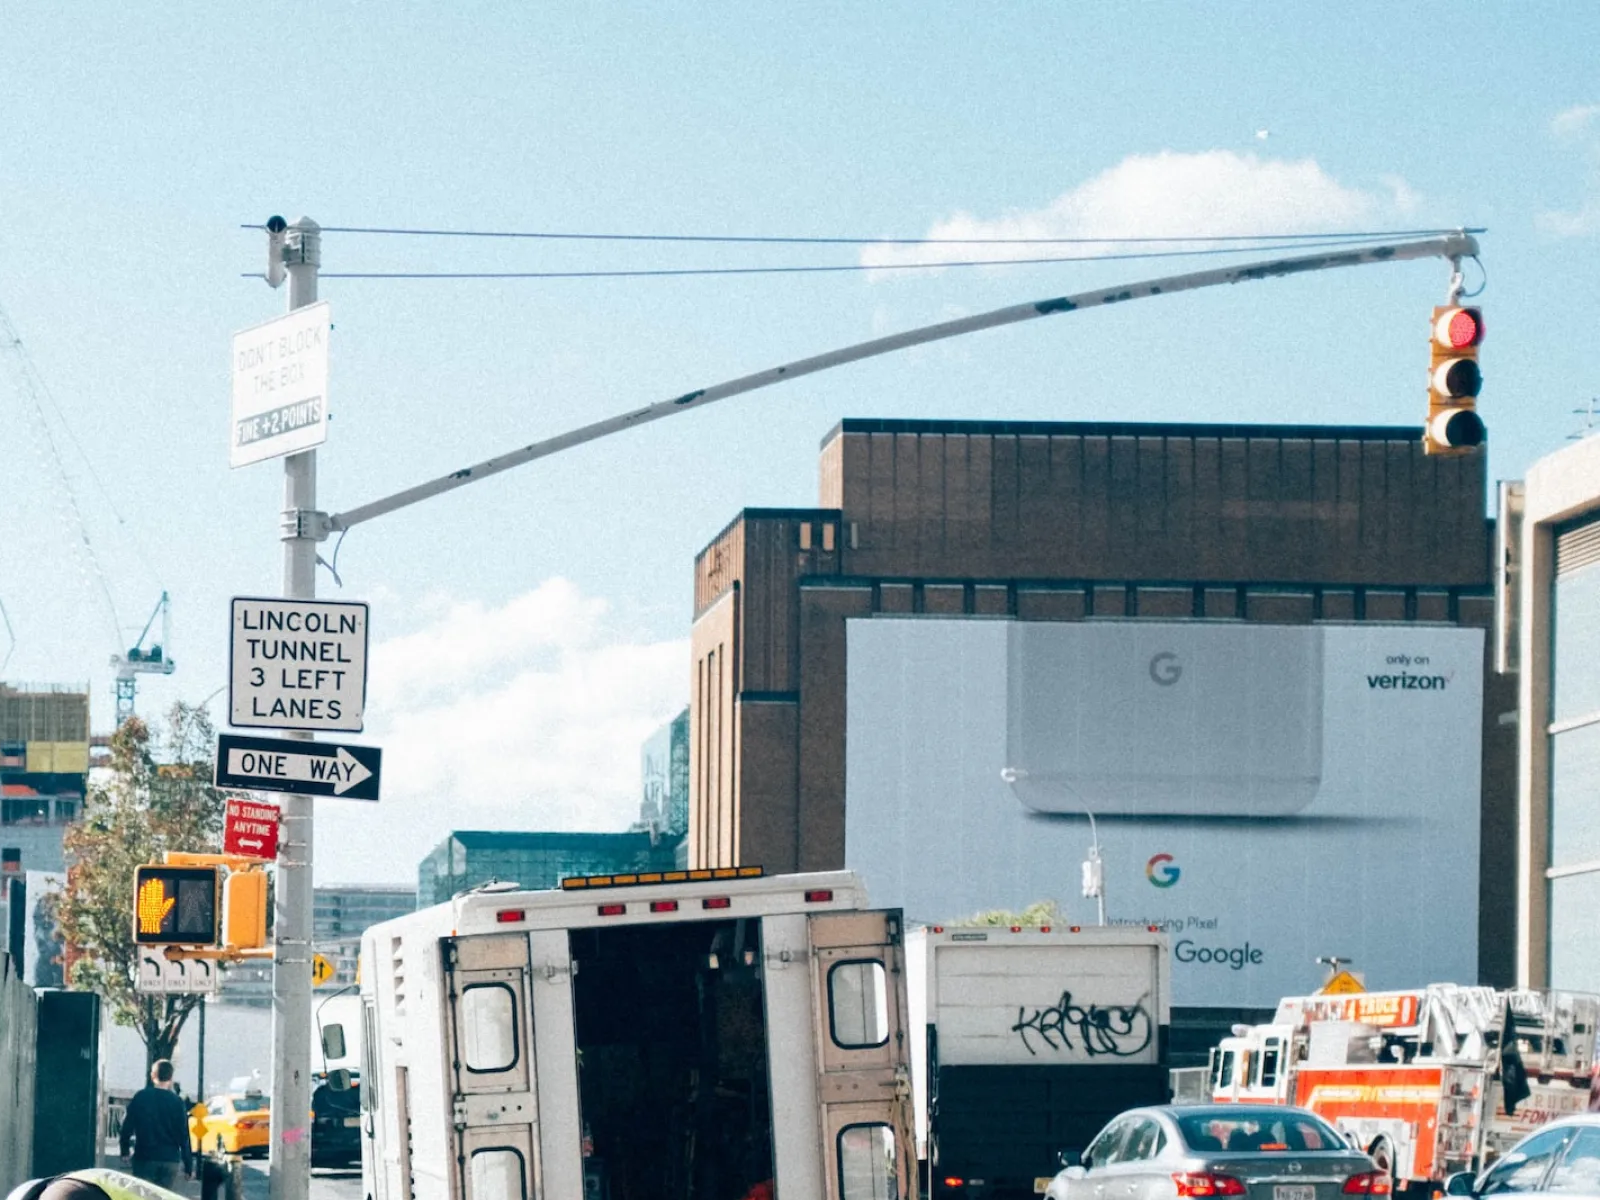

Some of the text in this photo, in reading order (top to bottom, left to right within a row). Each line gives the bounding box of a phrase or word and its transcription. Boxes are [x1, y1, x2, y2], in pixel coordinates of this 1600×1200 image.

[238, 326, 322, 372] DON'T BLOCK
[253, 370, 276, 394] THE
[280, 398, 321, 431] POINTS
[243, 609, 356, 634] LINCOLN
[246, 639, 351, 663] TUNNEL
[1386, 654, 1430, 666] only on
[250, 667, 346, 691] 3 LEFT
[1366, 671, 1446, 690] verizon
[253, 696, 342, 720] LANES
[241, 752, 356, 782] ONE WAY
[229, 805, 278, 822] NO STANDING
[233, 820, 271, 836] ANYTIME
[1187, 917, 1218, 929] Pixel
[1175, 940, 1263, 970] Google
